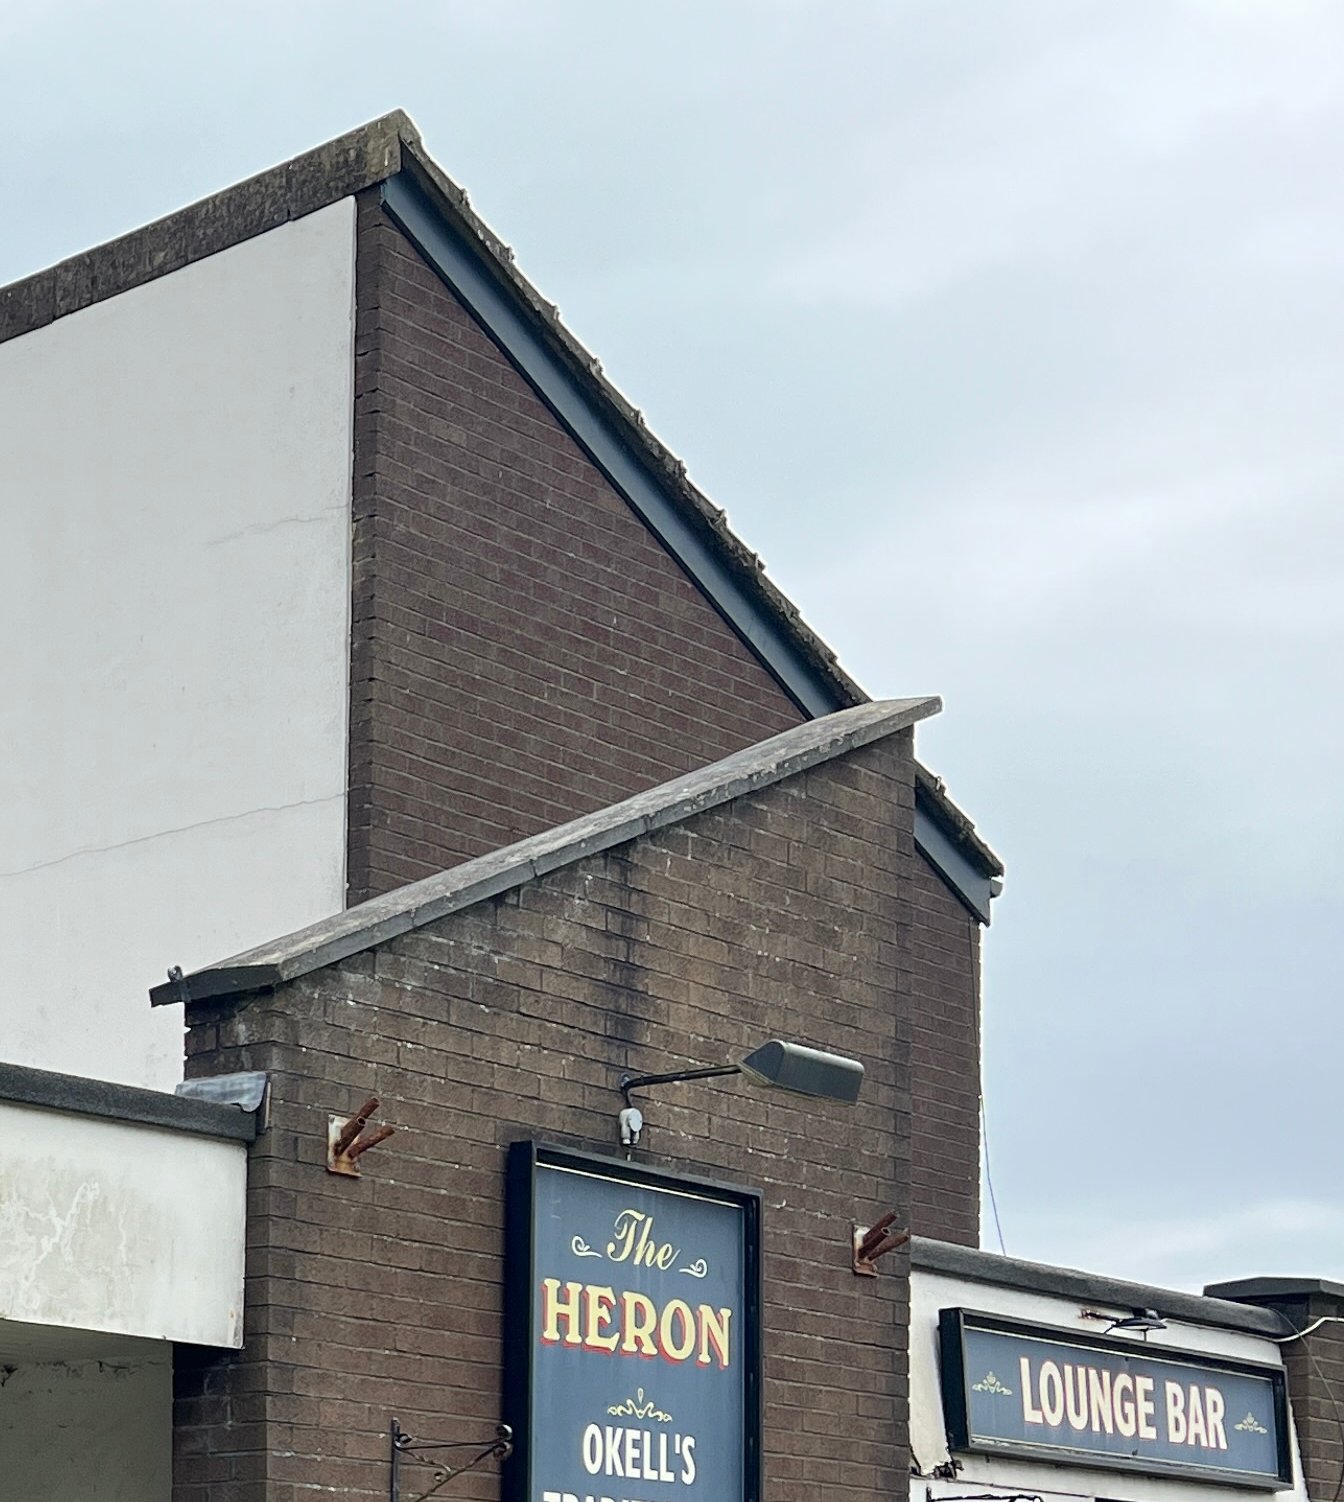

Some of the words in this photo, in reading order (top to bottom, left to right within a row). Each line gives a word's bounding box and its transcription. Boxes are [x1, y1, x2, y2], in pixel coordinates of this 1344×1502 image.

[606, 1208, 680, 1271] The
[540, 1278, 732, 1371] HERON
[1019, 1357, 1157, 1440] LOUNGE
[1164, 1380, 1228, 1450] BAR
[582, 1422, 697, 1486] OKELL'S
